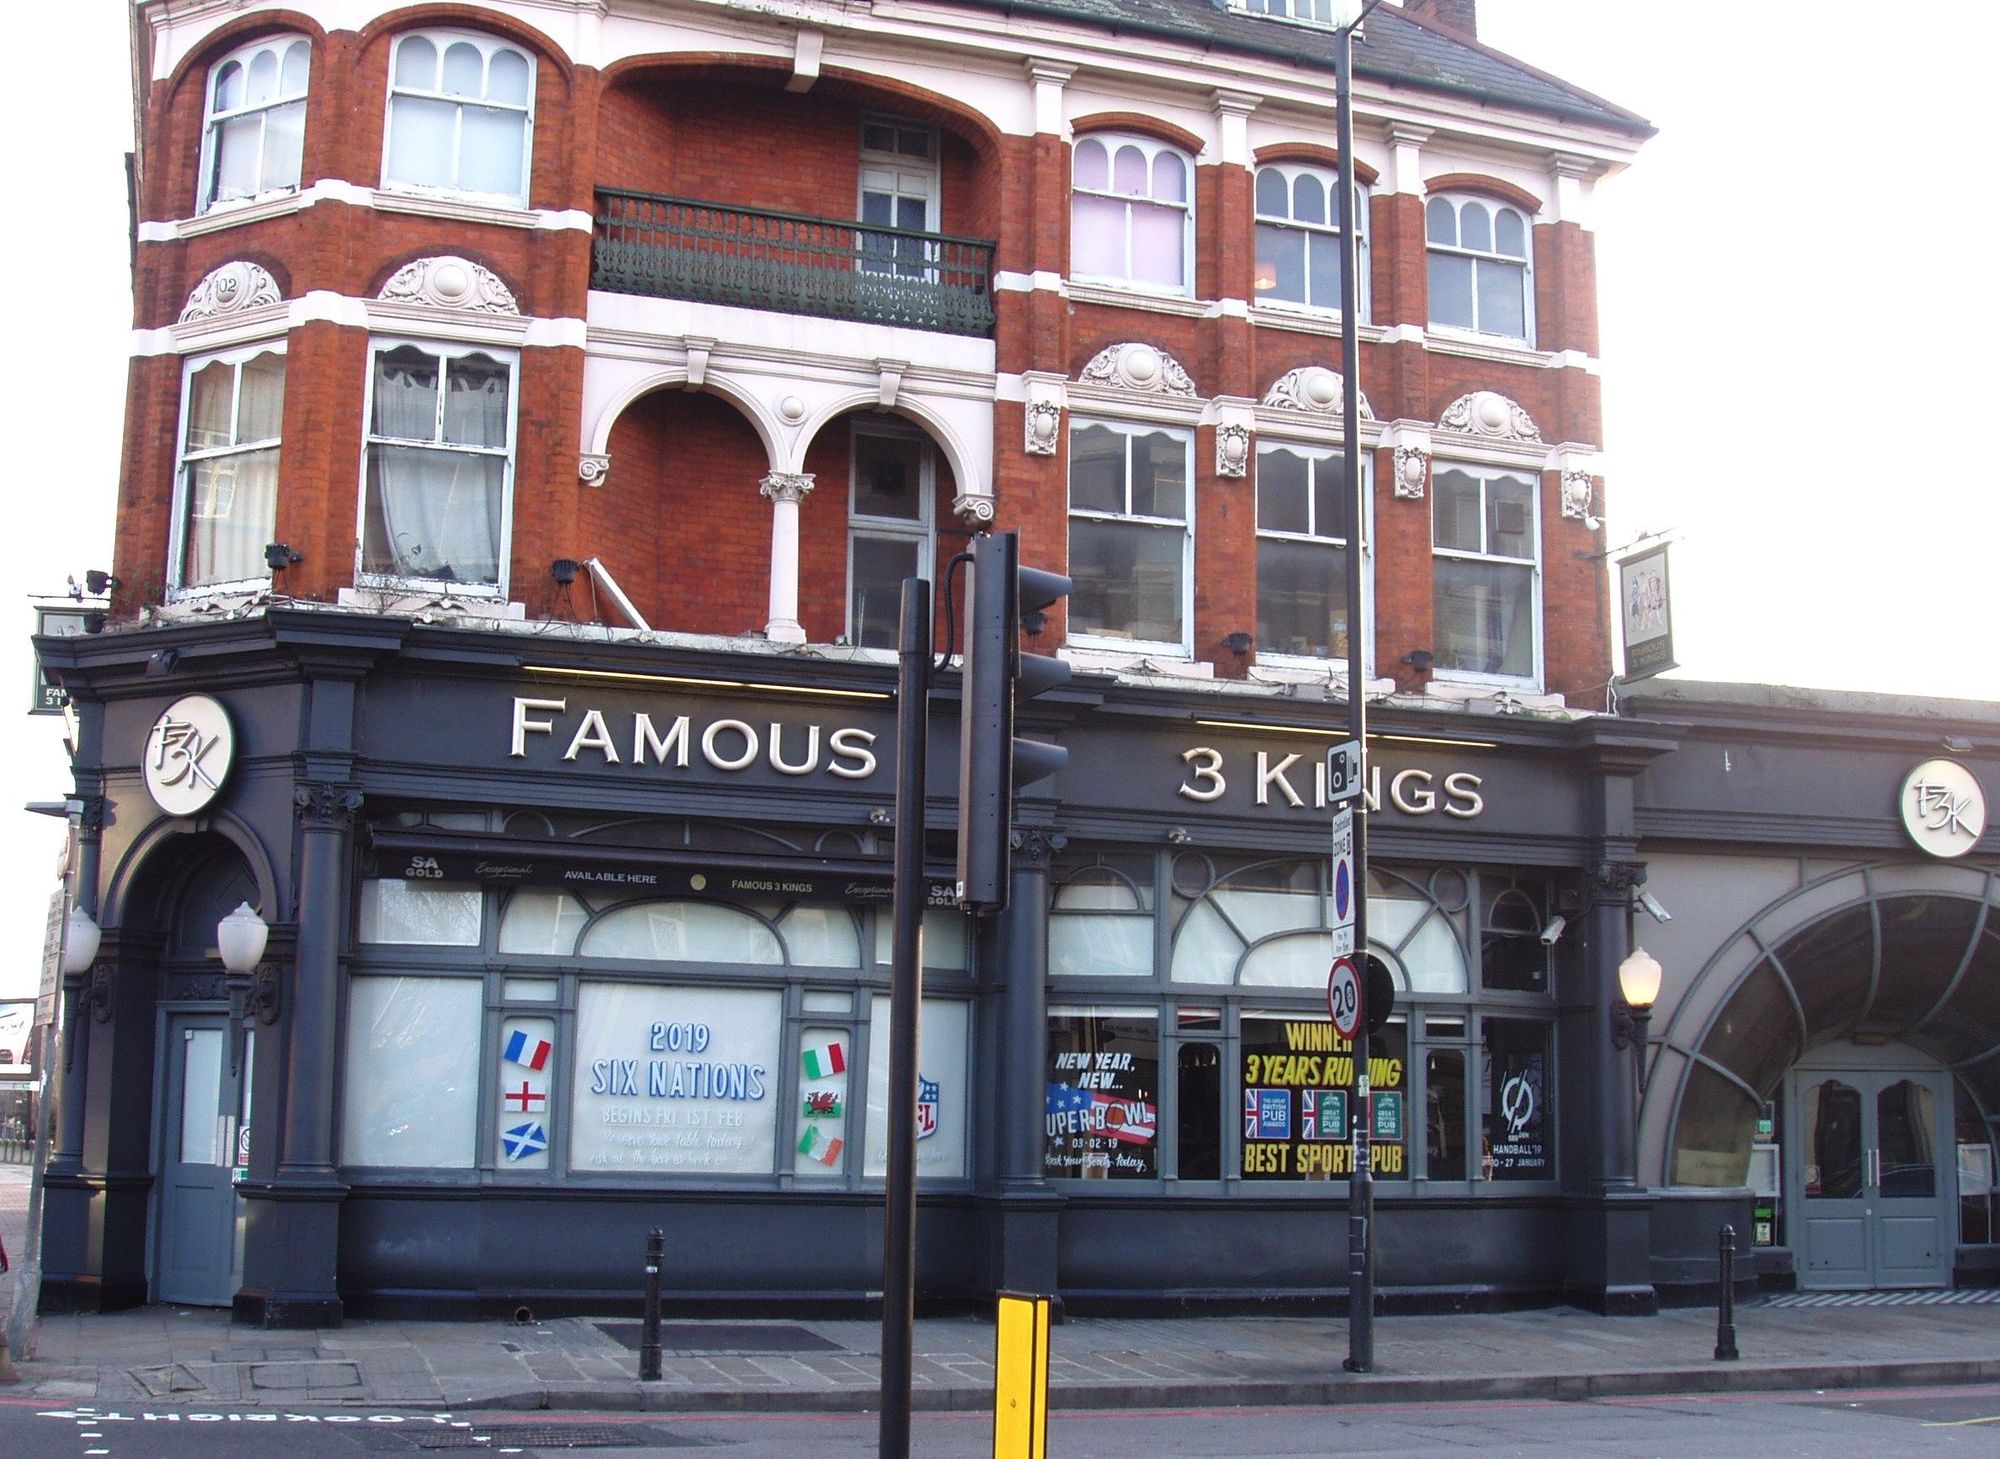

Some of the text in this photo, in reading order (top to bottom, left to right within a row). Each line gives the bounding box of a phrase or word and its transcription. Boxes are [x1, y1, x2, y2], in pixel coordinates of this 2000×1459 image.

[215, 279, 237, 295] 102
[511, 696, 877, 780] FAMOUS
[1179, 747, 1227, 801] 3
[405, 868, 444, 879] GOLD
[564, 870, 658, 884] AVAILABLE HERE
[731, 879, 774, 892] FAMOUS
[782, 882, 813, 893] KINGS
[844, 882, 895, 896] Exceptiona
[1332, 980, 1356, 1018] 20
[650, 1021, 710, 1052] 2019
[1285, 1022, 1353, 1053] WINNE
[1055, 1053, 1136, 1072] NEW YEAR,
[1245, 1054, 1261, 1085] 3
[1262, 1055, 1322, 1087] YEARS
[1322, 1056, 1403, 1088] RUING
[590, 1059, 766, 1101] SIX NATIONS
[1077, 1072, 1124, 1090] NEW...
[602, 1107, 651, 1124] BEGINS
[656, 1108, 676, 1125] FRI
[718, 1110, 744, 1127] FEB
[1046, 1109, 1091, 1137] UPER
[1262, 1110, 1287, 1121] PUB
[1377, 1121, 1396, 1129] PUB
[1244, 1143, 1403, 1174] BEST SPORT PUB
[1504, 1158, 1514, 1167] 27
[1516, 1158, 1546, 1168] JANUARY
